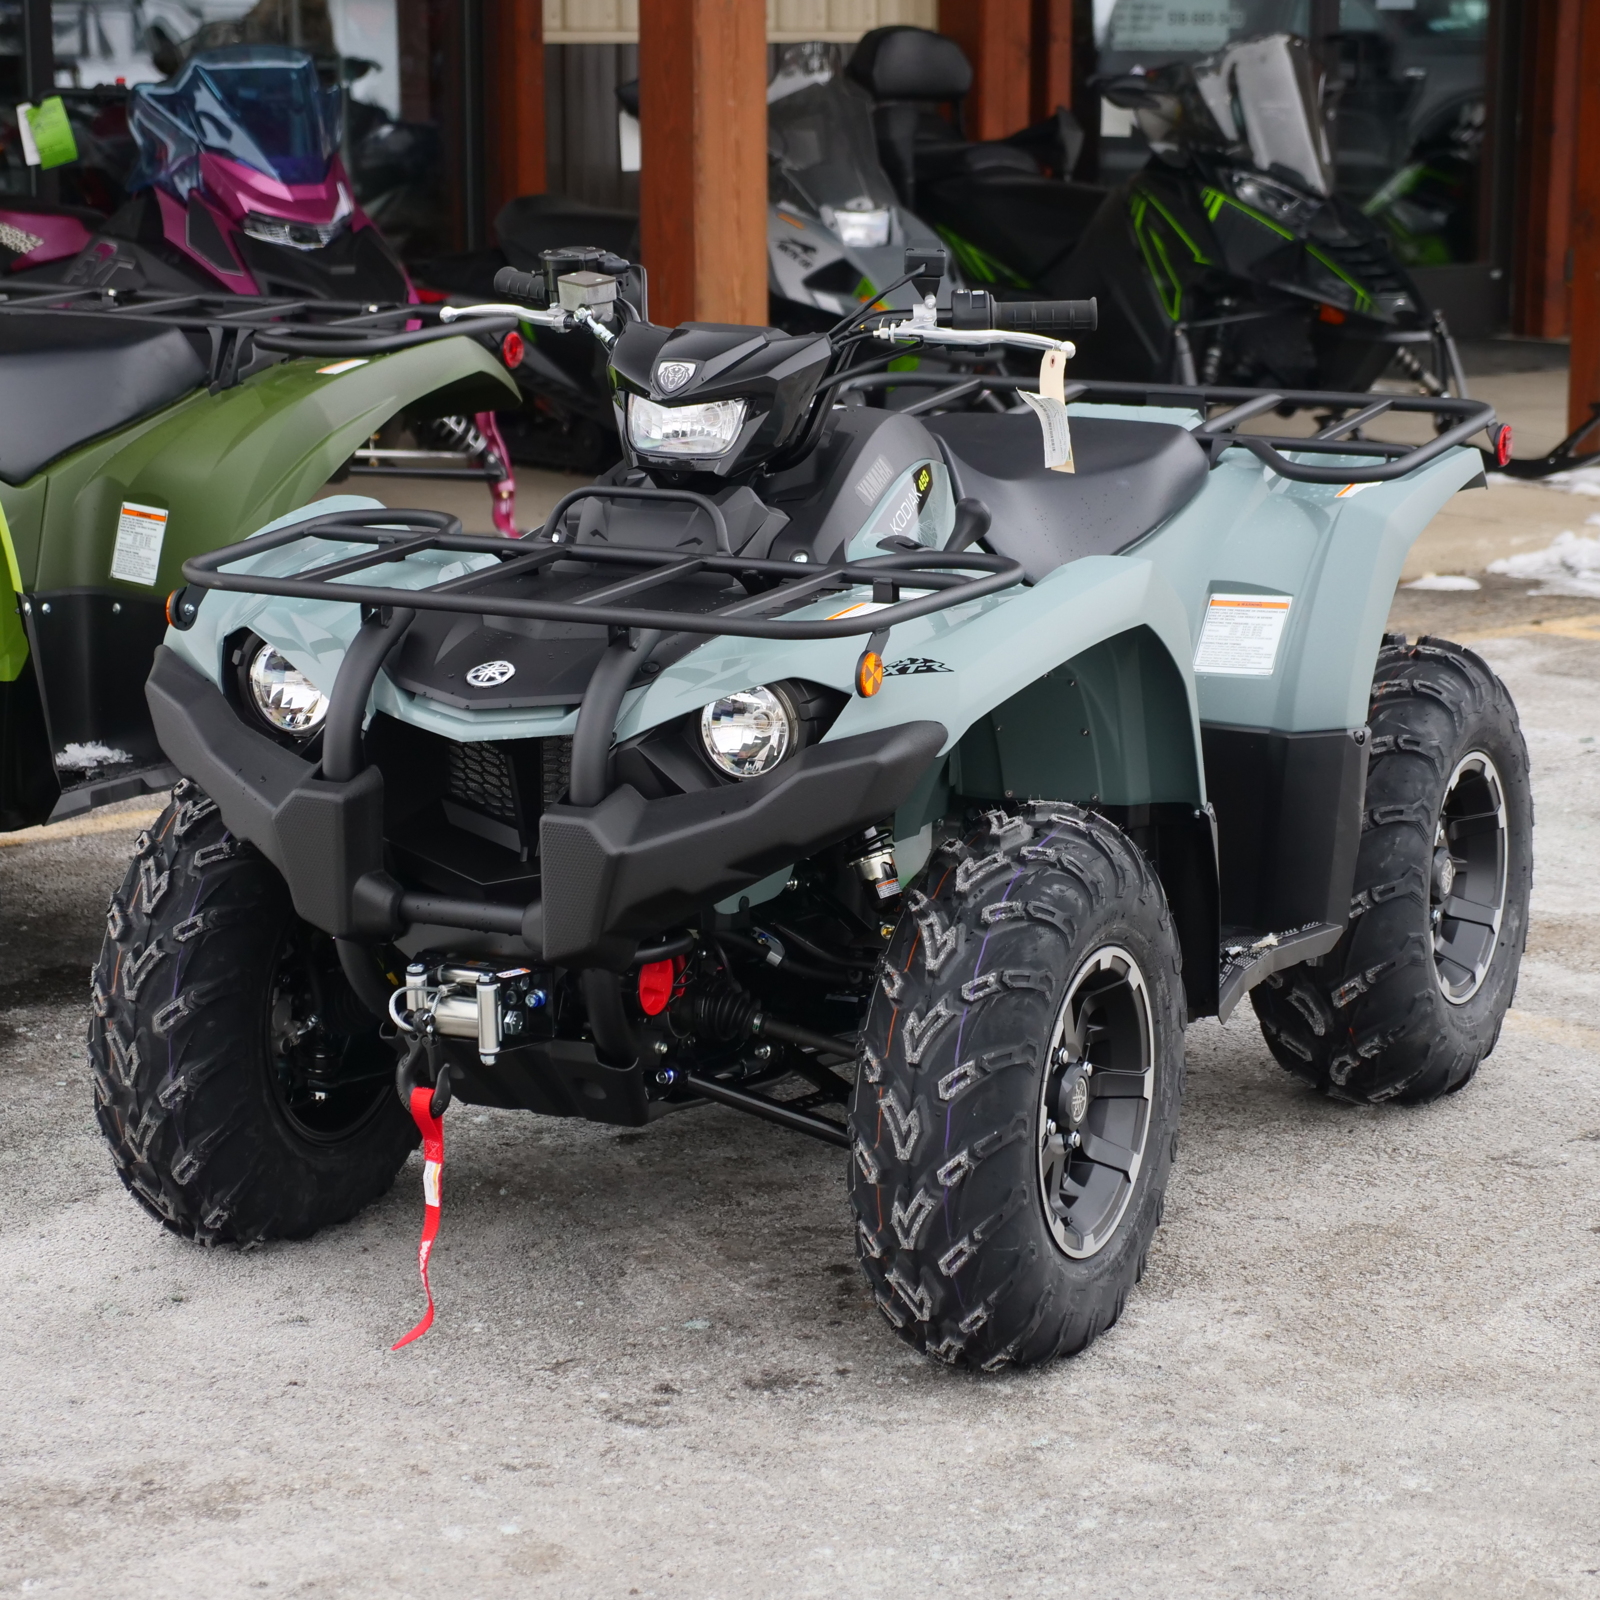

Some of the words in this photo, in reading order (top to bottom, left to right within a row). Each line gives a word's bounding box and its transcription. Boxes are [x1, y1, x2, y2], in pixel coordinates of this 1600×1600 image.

[857, 458, 893, 501] YAMAHA
[890, 483, 922, 535] KODIAK
[918, 469, 930, 491] 450
[883, 662, 950, 675] XT-R
